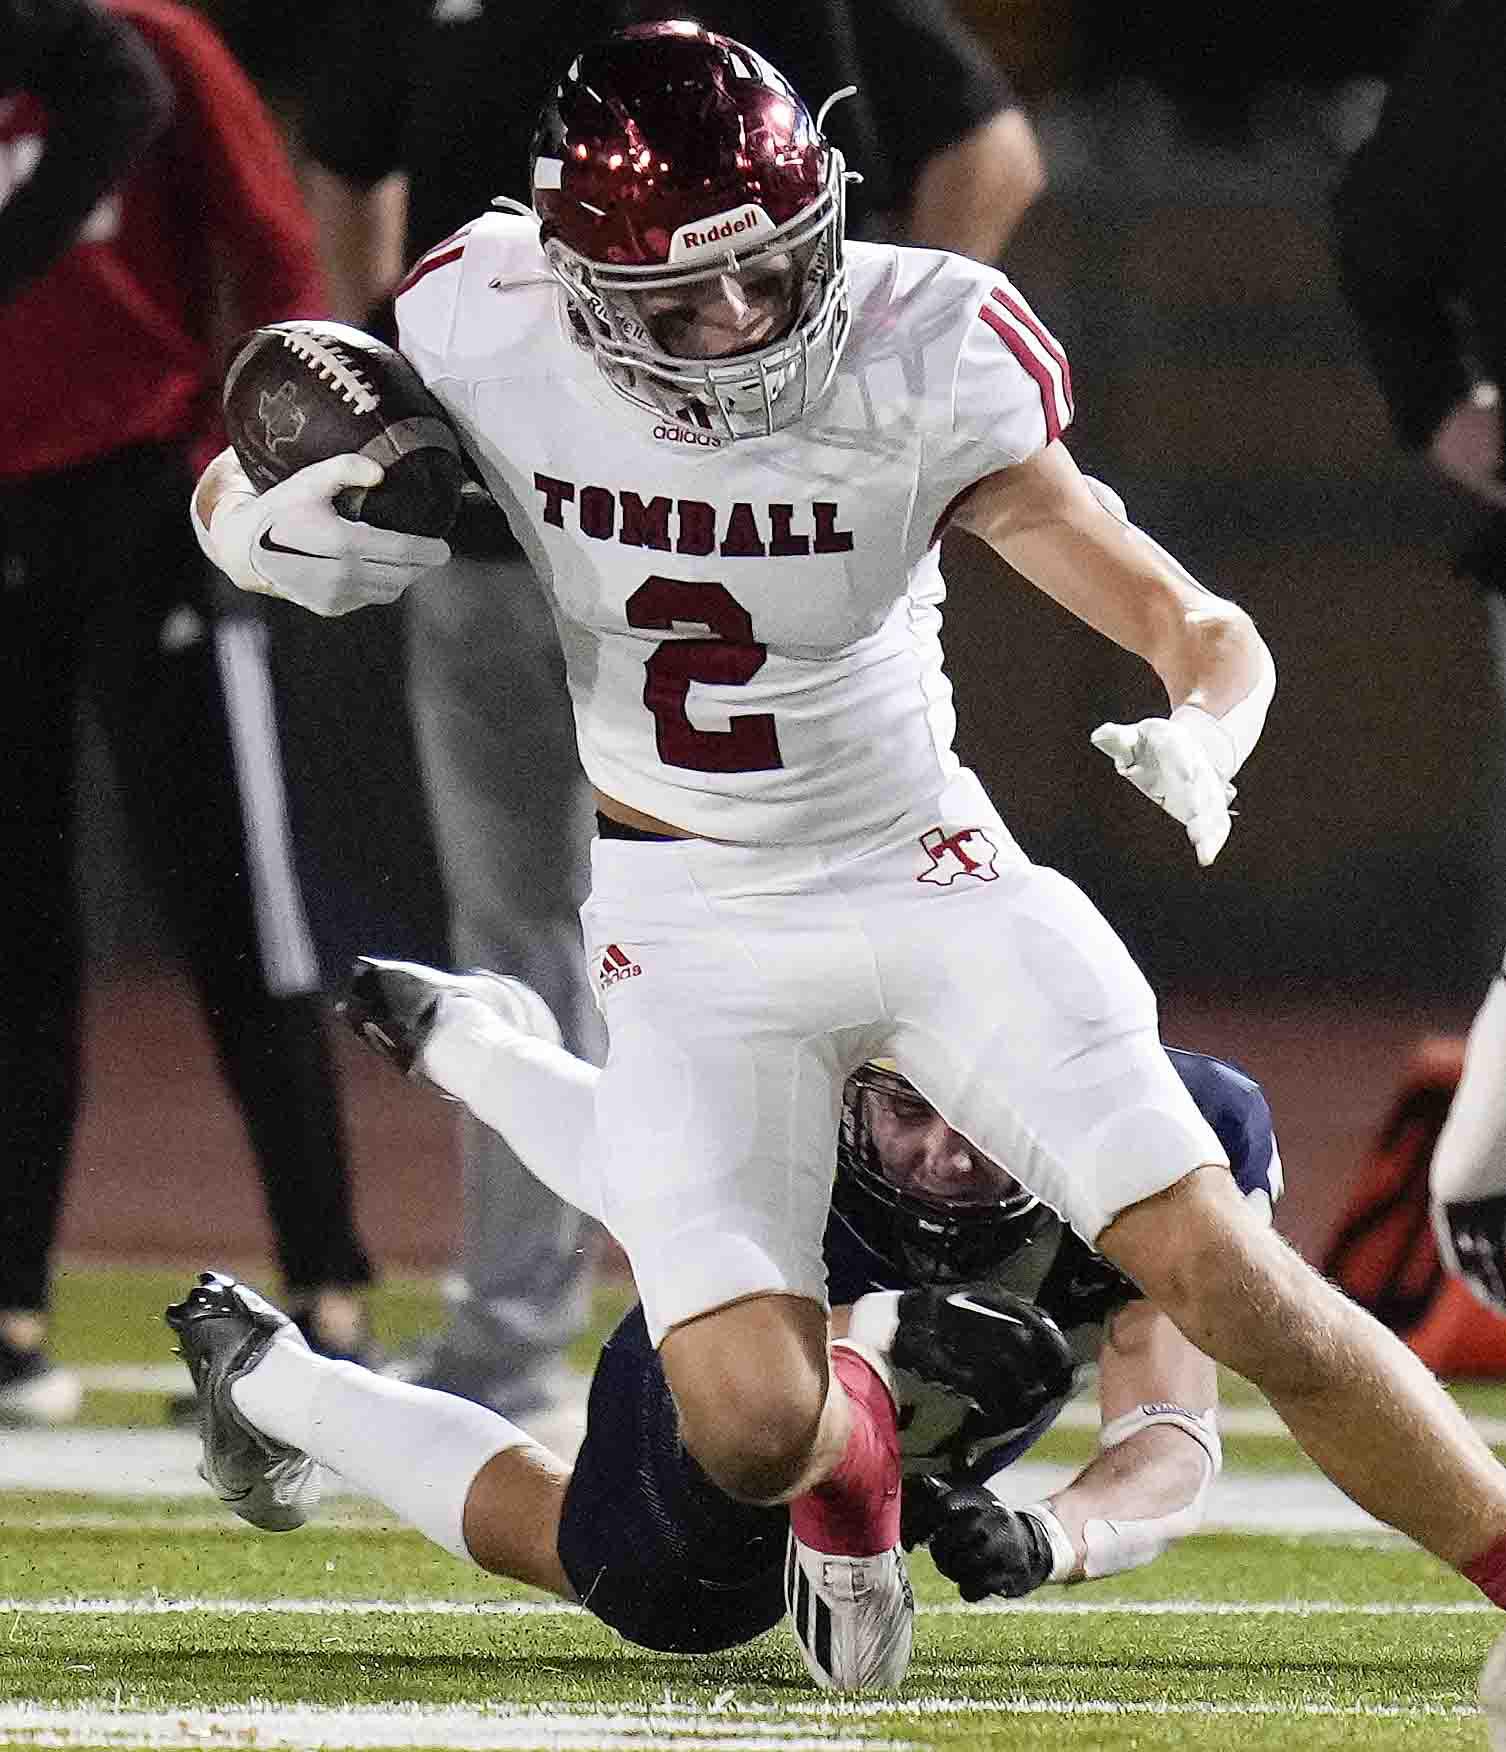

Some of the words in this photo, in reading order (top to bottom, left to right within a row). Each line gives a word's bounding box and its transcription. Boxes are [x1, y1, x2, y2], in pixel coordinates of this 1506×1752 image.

[682, 209, 758, 248] Riddell
[653, 426, 721, 447] adidas
[533, 472, 854, 557] TOMBALL
[625, 575, 784, 773] 2
